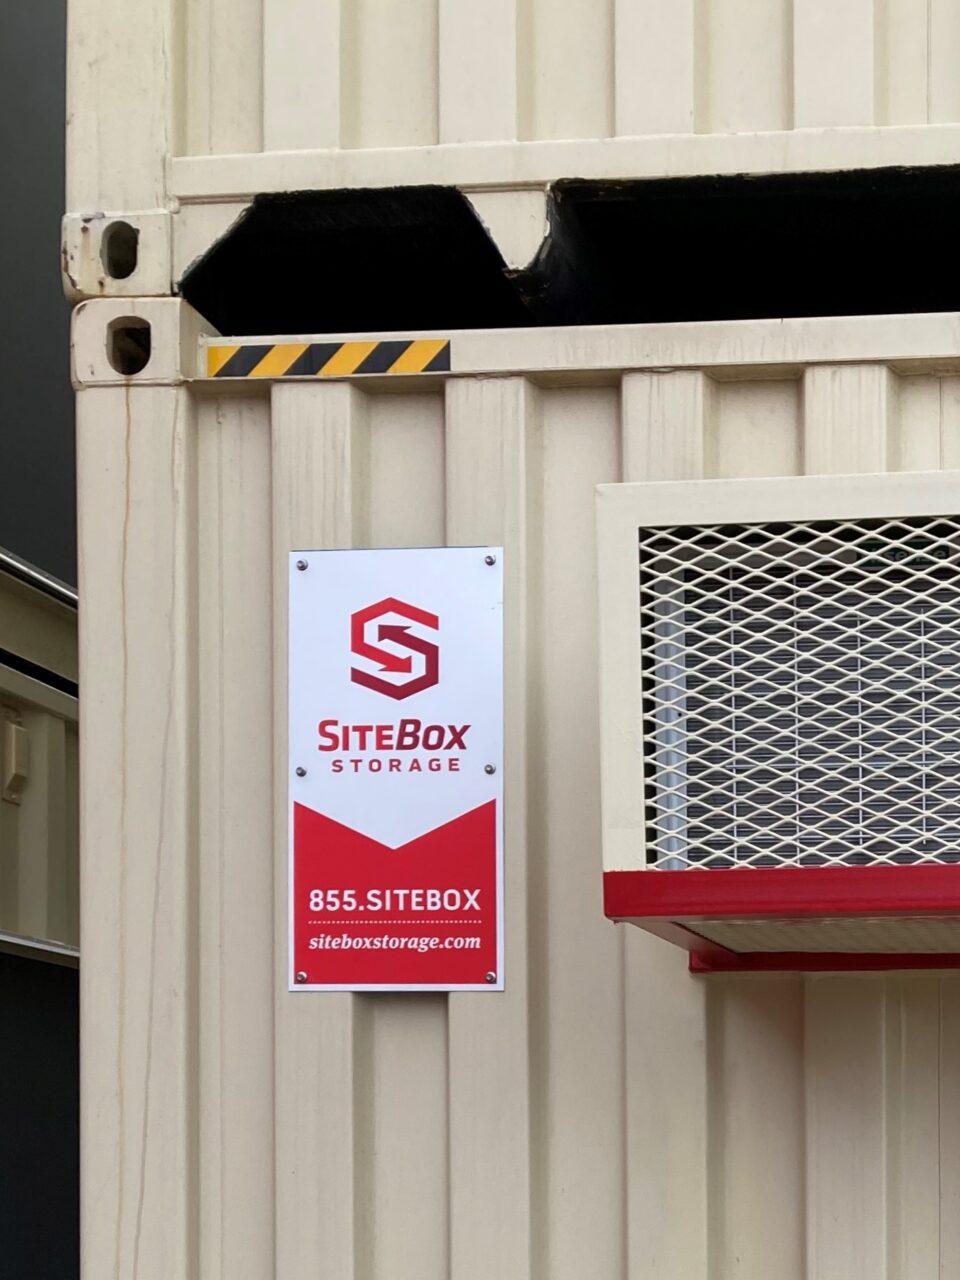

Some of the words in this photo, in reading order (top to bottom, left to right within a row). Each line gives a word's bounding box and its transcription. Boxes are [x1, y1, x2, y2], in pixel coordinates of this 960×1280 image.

[332, 758, 460, 773] STORAGE
[308, 889, 482, 911] 855.SITEBOX
[308, 933, 482, 952] siteboxstorage.com
